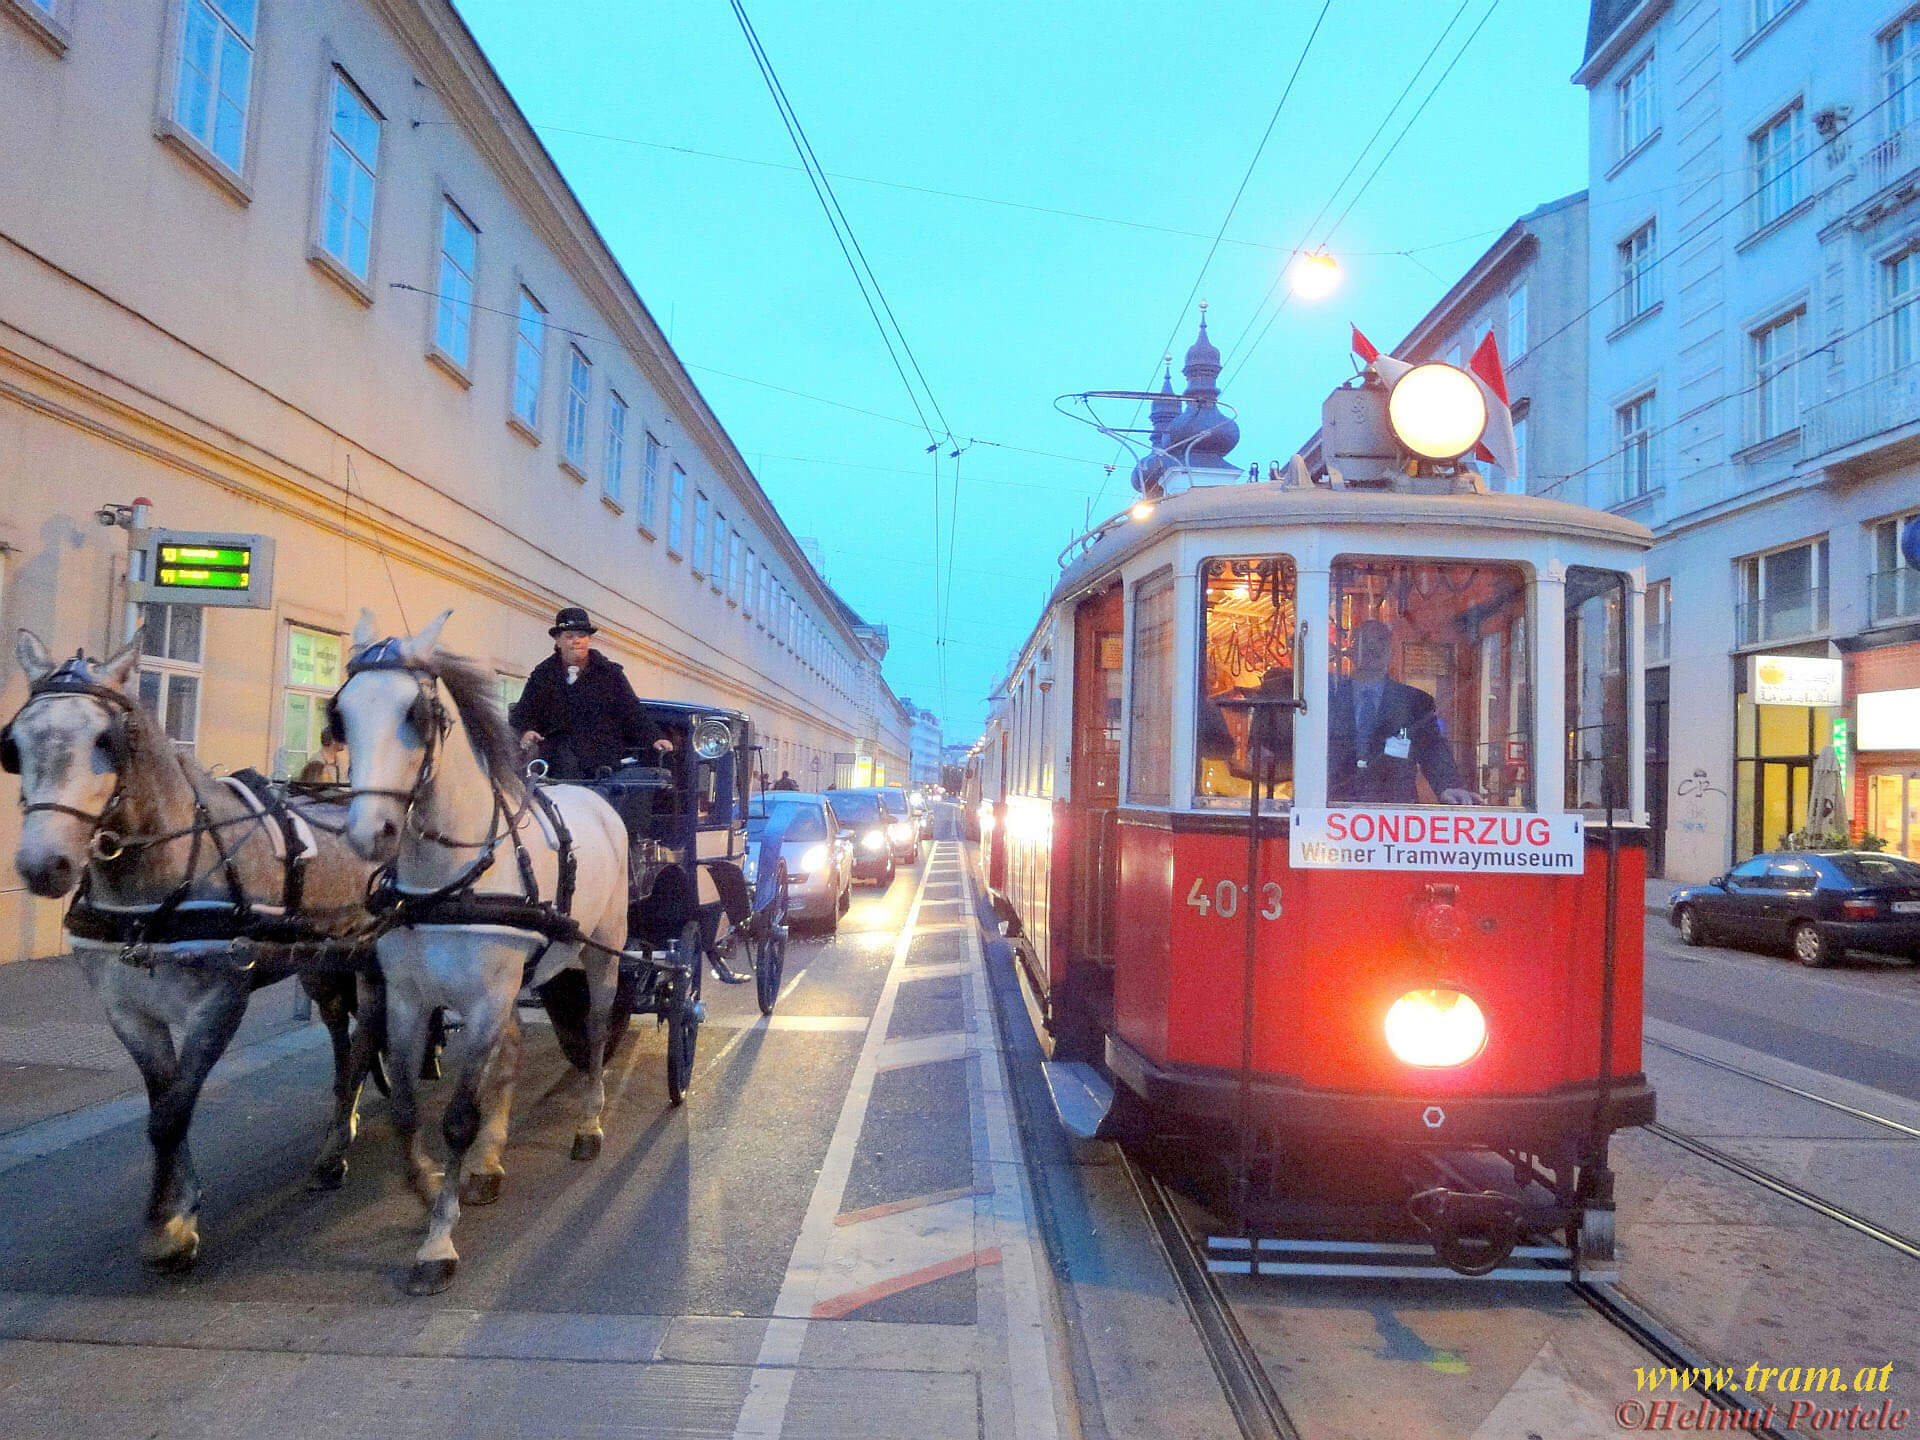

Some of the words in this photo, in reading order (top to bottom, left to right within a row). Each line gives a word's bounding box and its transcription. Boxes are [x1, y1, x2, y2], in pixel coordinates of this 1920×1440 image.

[1326, 813, 1551, 846] SONDERZUG
[1301, 842, 1376, 864] Wiener
[1383, 844, 1575, 870] Tramwaymuseum
[1186, 877, 1283, 921] 403
